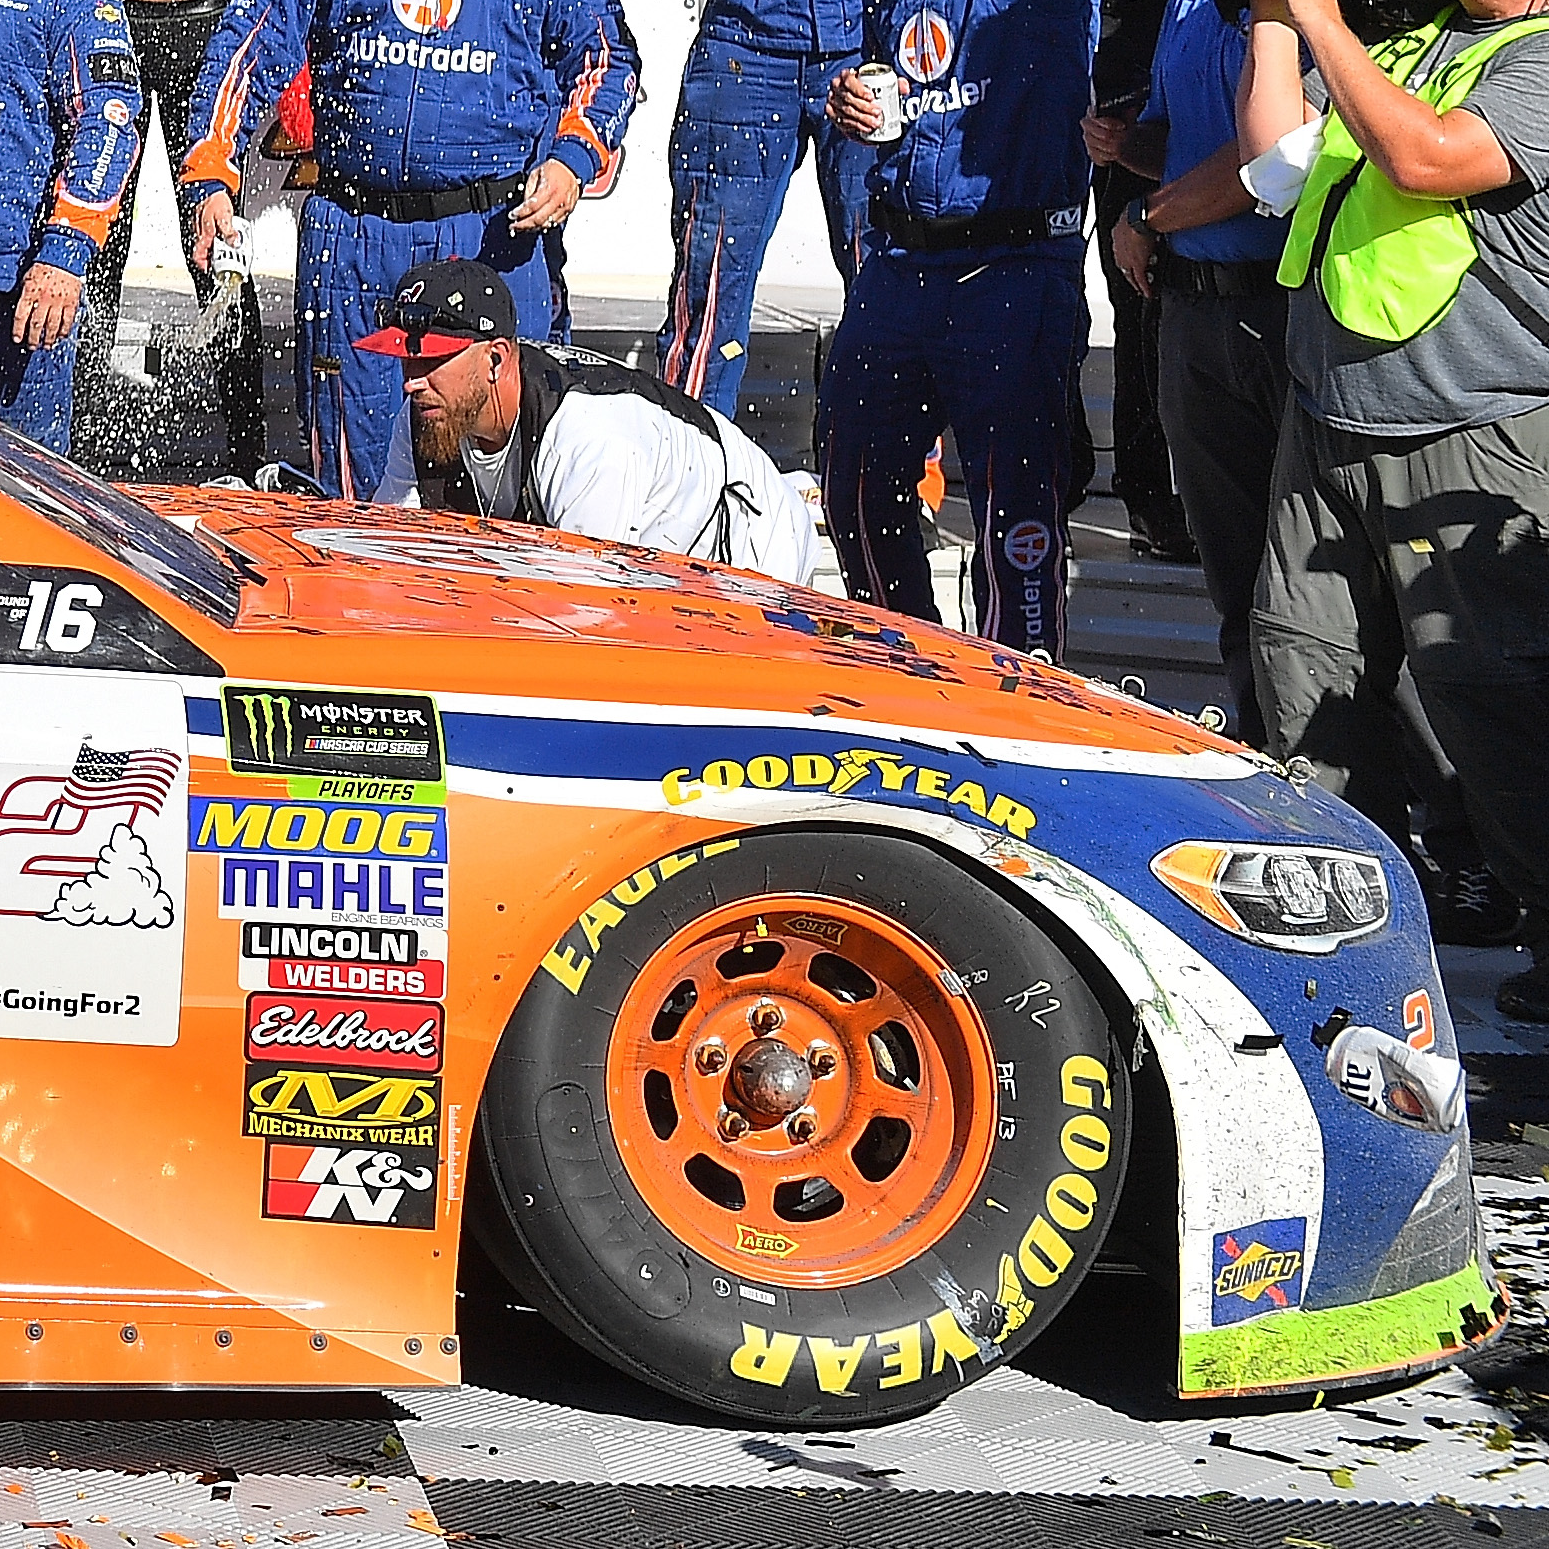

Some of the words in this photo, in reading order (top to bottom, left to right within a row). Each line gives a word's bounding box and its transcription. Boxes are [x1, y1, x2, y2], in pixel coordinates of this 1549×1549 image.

[9, 608, 28, 619] OF
[19, 580, 104, 653] 16
[300, 702, 428, 726] MONSTER
[319, 739, 364, 753] NASCAR
[365, 741, 388, 754] CUP
[389, 743, 429, 755] SERIES
[321, 726, 409, 737] ENERGY
[318, 780, 414, 800] PLAYOFFS
[197, 802, 438, 857] MOOG
[222, 857, 444, 917] MAHLE
[331, 912, 378, 925] ENGINE
[380, 915, 444, 929] BEARINGS
[250, 927, 410, 962] LINCOLN
[284, 963, 425, 994] WELDERS
[249, 1004, 437, 1057] Edelbrock
[248, 1113, 363, 1142] MECHANIX
[368, 1124, 435, 1147] WEAR
[742, 1235, 789, 1252] AERO
[1219, 1252, 1301, 1291] SUNOCO
